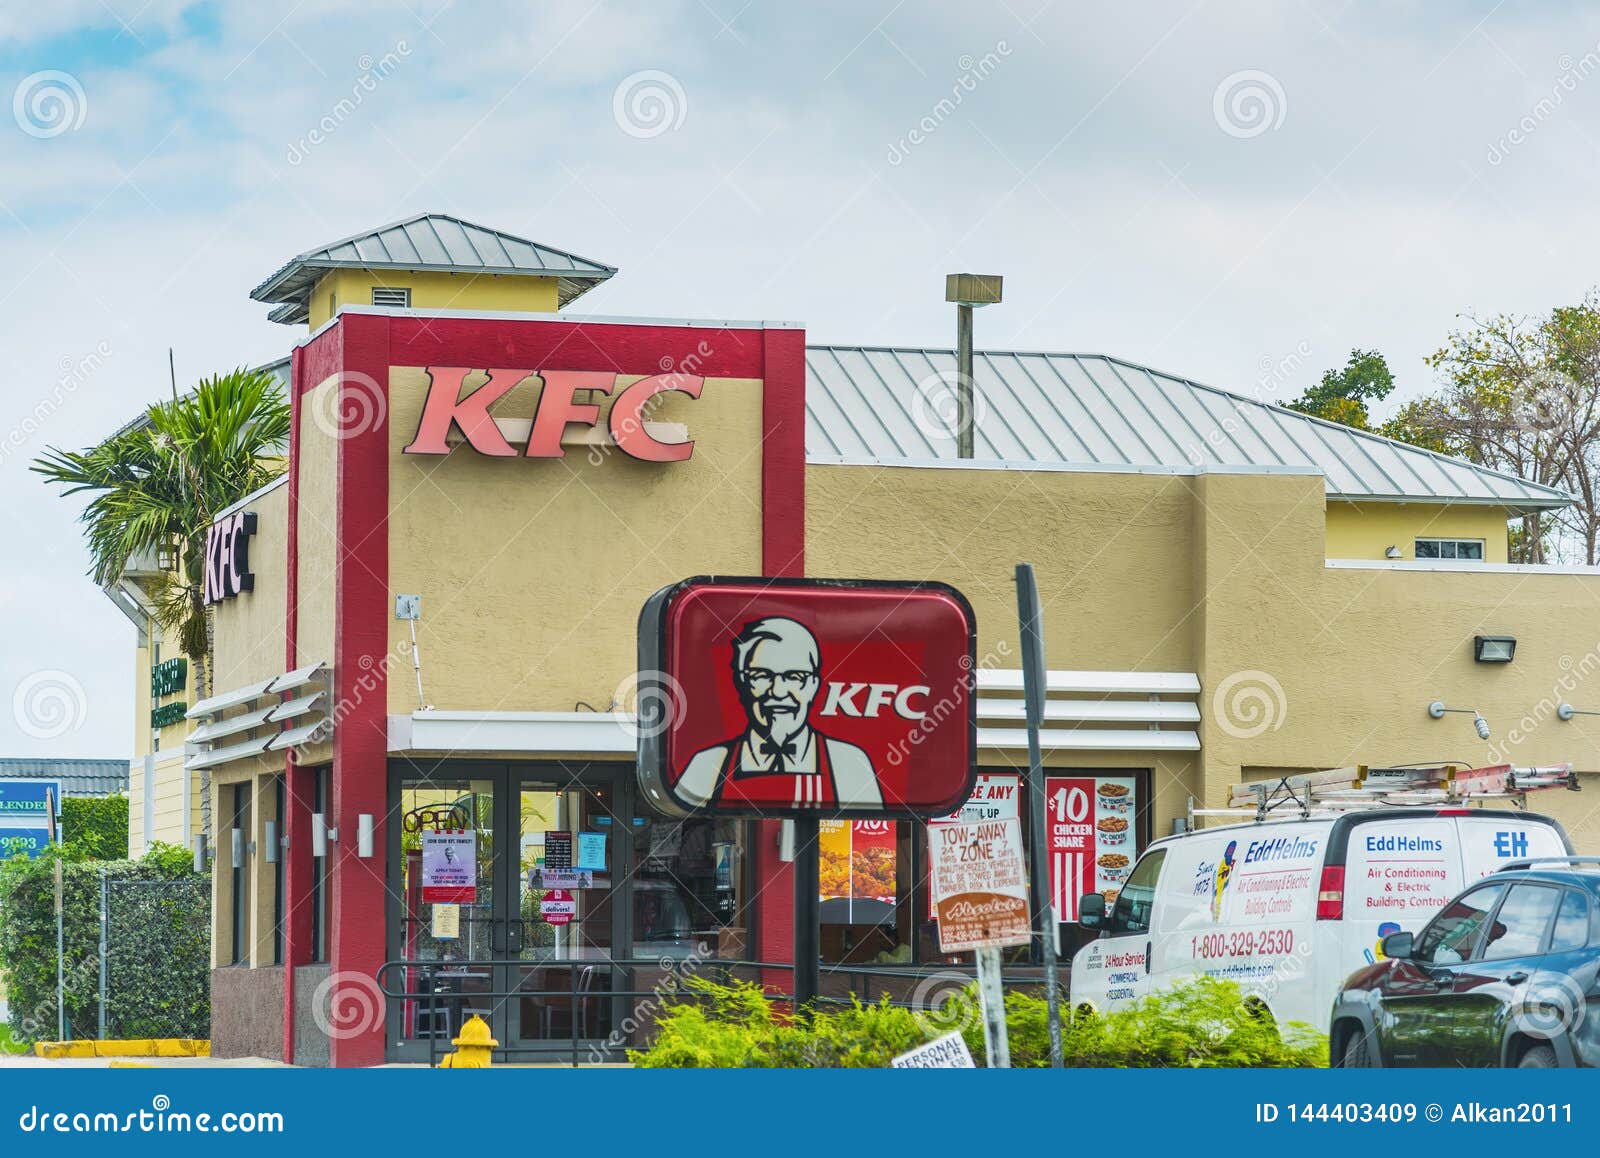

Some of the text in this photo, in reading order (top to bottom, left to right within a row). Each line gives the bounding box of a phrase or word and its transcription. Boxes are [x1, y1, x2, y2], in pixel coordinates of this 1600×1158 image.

[402, 366, 705, 462] KFC
[203, 511, 257, 606] KFC
[820, 681, 931, 721] KFC
[987, 786, 1014, 799] ANY
[403, 807, 467, 833] OPEN
[987, 808, 1000, 818] UP
[940, 823, 1007, 846] TOW-AWAY
[1053, 824, 1092, 836] CHICKEN
[1053, 836, 1085, 848] SHARE
[1493, 831, 1529, 857] EH
[959, 843, 994, 862] ZONE
[1368, 867, 1446, 881] Air Conditioning
[1384, 882, 1431, 892] & Electric
[1366, 896, 1406, 909] Building
[1192, 929, 1294, 959] 1-800-329-2530
[1125, 952, 1145, 966] Service
[921, 1047, 962, 1068] AINER
